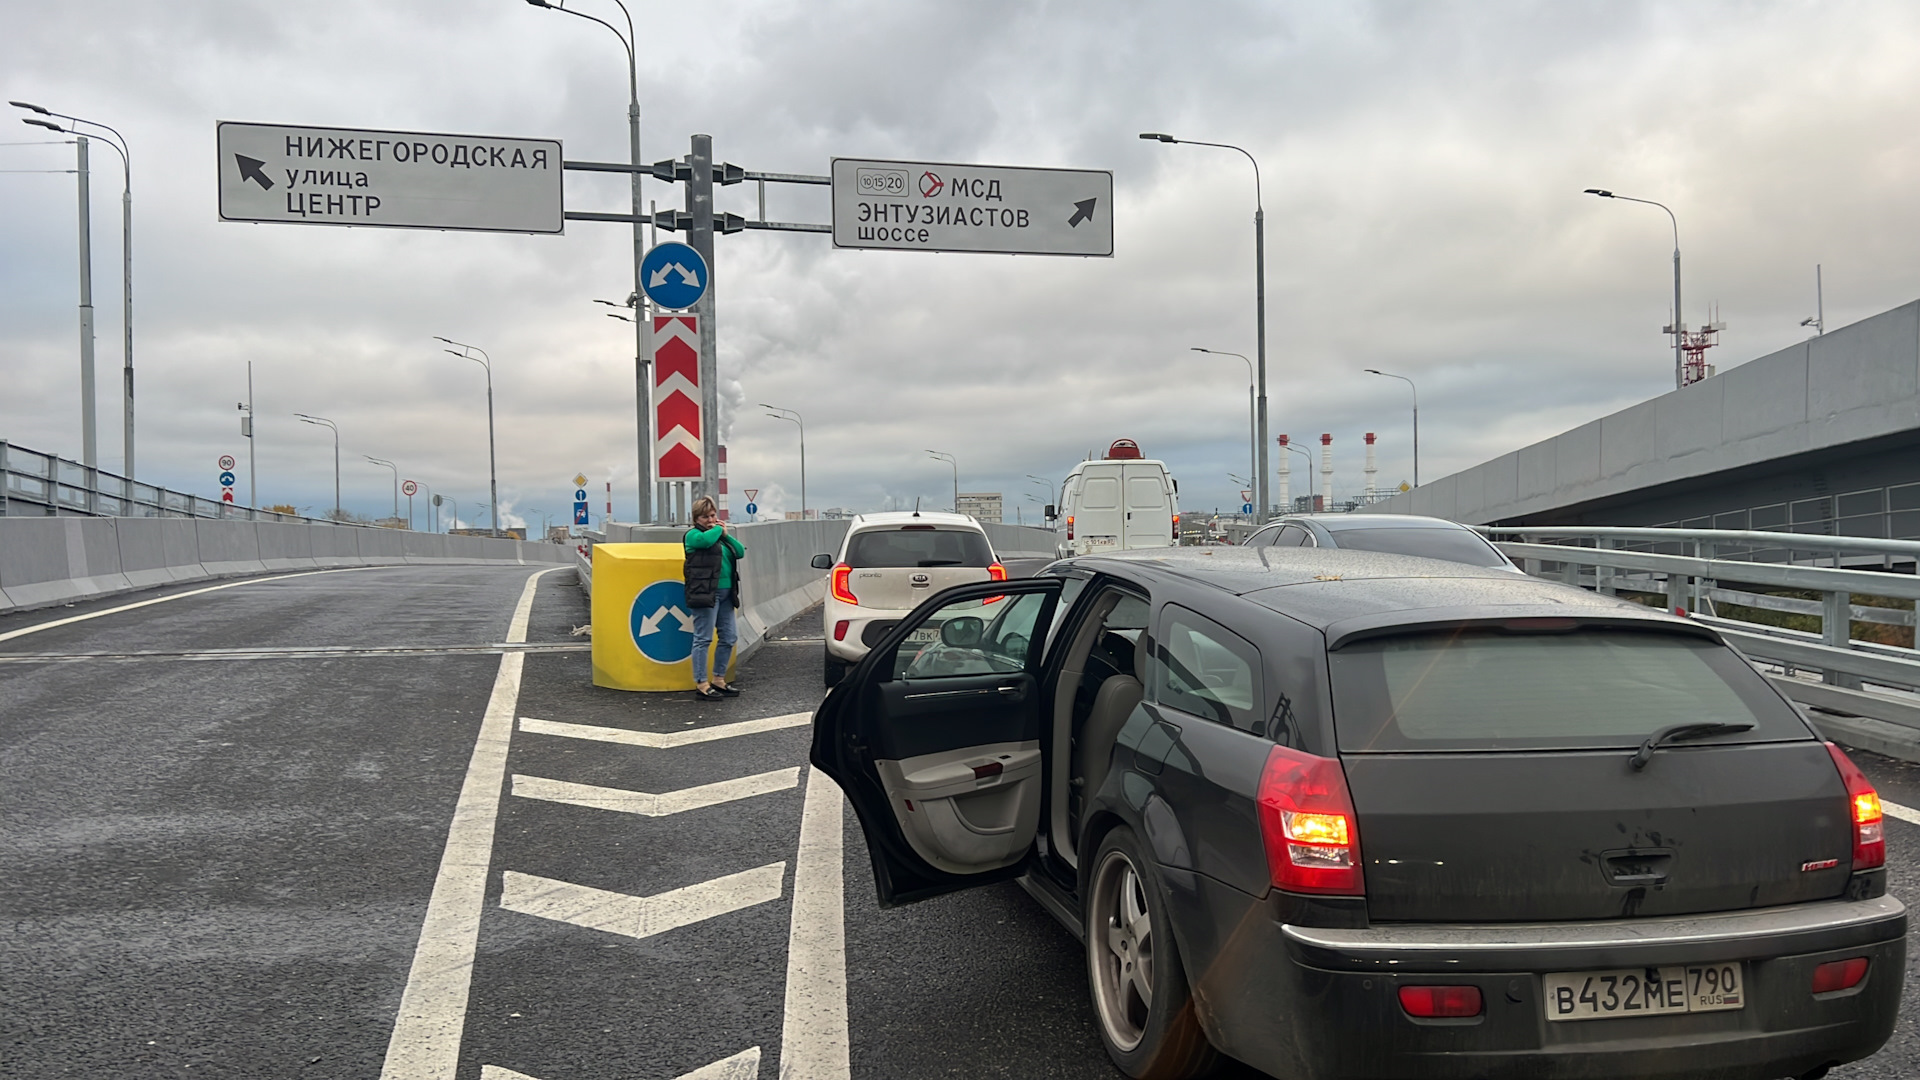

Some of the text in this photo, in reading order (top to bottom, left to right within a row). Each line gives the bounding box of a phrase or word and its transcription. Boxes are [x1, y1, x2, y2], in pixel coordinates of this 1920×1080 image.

[285, 135, 548, 170] НИЖЕГОРОДСКАЯ
[285, 168, 369, 189] улица
[863, 176, 1002, 202] 10 15 20 МСД
[286, 192, 382, 217] ЦЕНТР
[857, 202, 1030, 228] ЭНТУЗИАСТОВ
[857, 226, 930, 243] шоссе
[221, 459, 232, 467] 90
[405, 484, 415, 492] 40
[913, 574, 928, 582] KIA
[1556, 966, 1737, 1015] В432МЕ 790
[1700, 994, 1723, 1006] RUS
